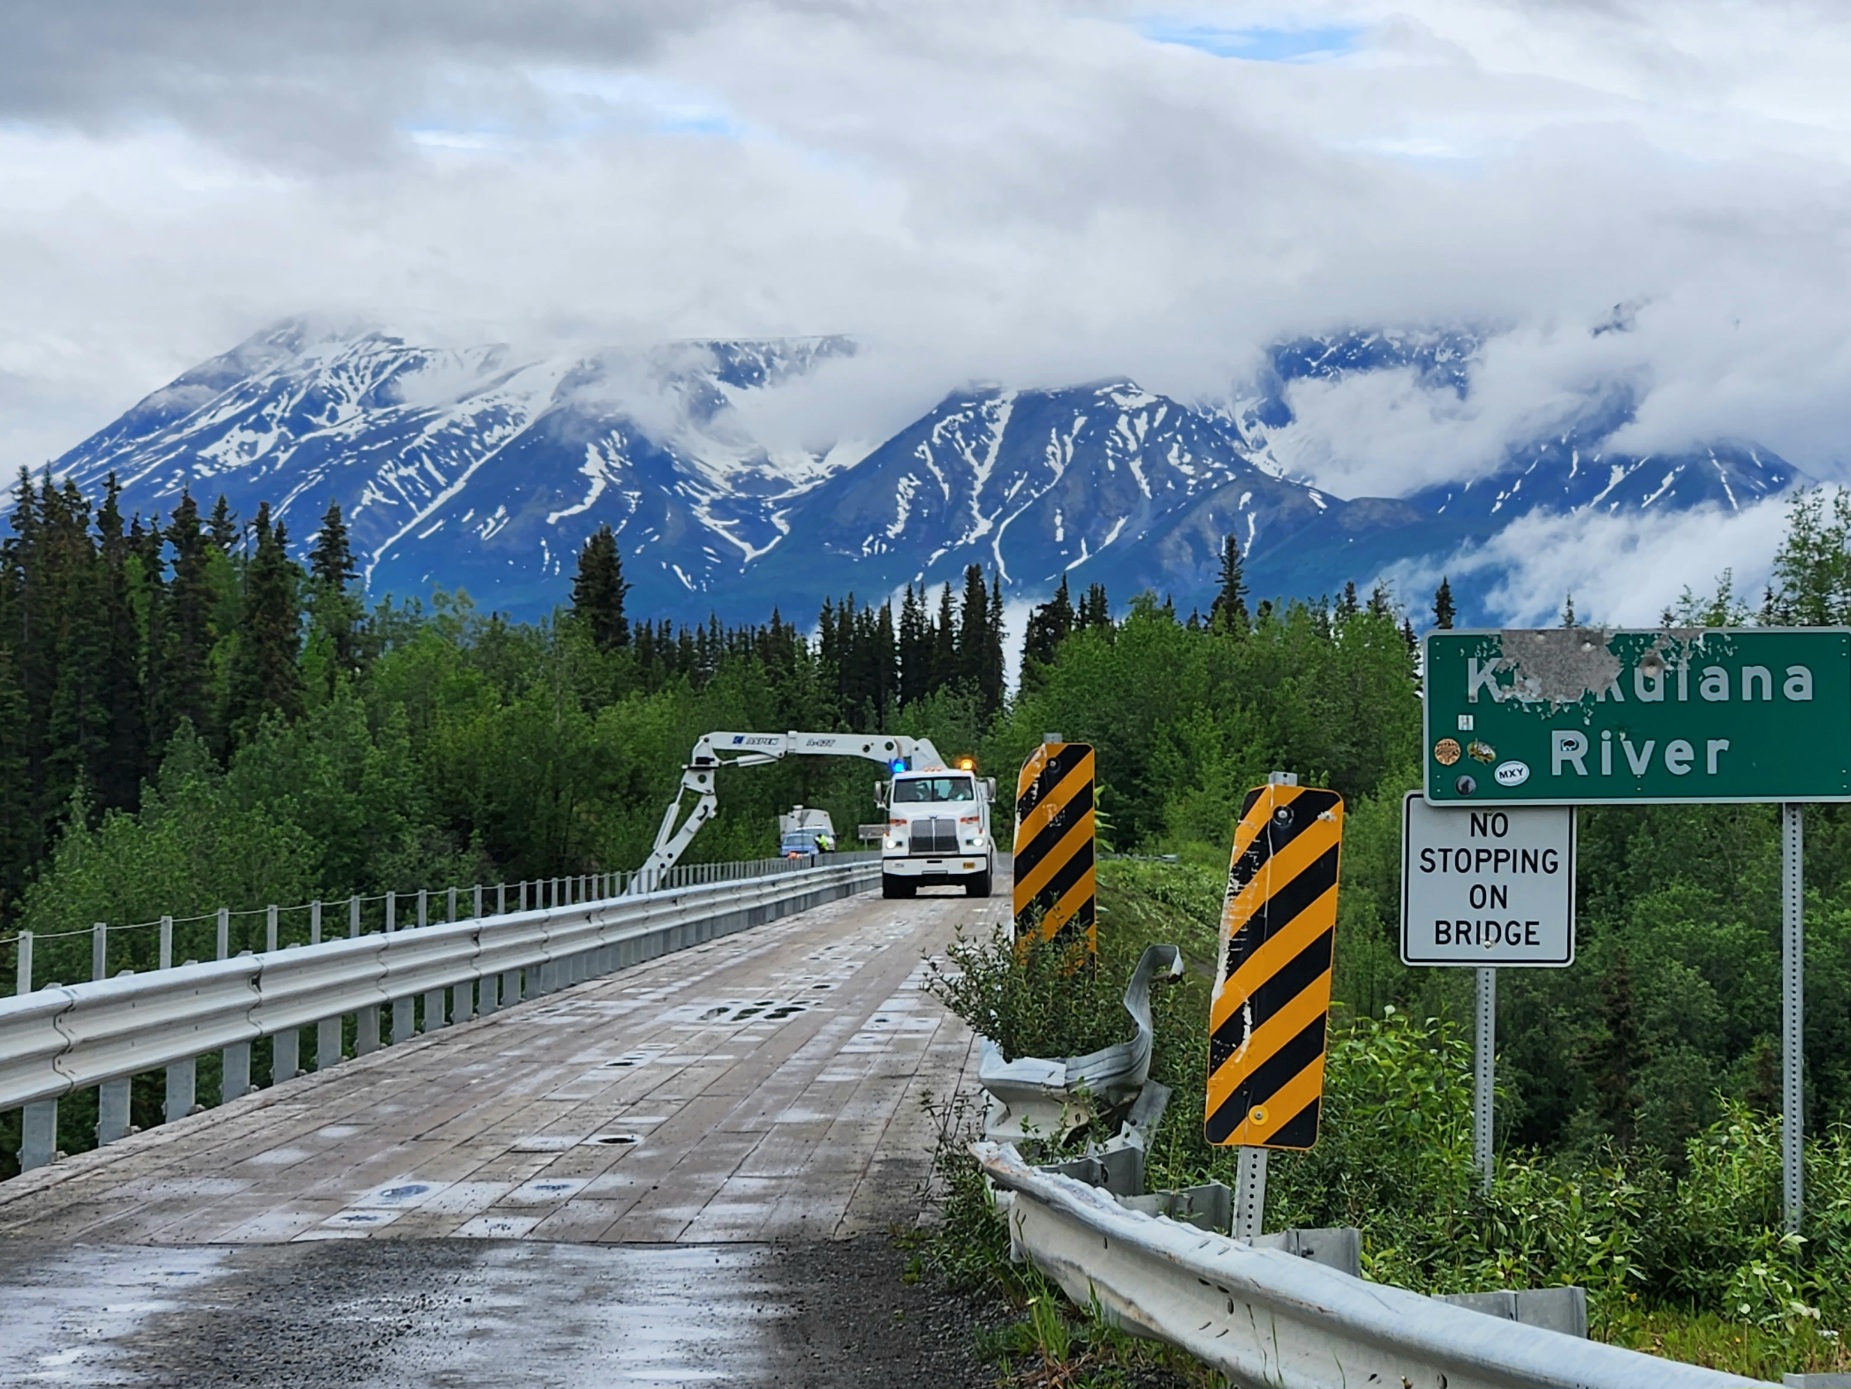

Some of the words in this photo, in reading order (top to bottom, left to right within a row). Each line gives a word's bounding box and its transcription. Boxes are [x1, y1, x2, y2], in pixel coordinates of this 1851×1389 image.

[1551, 730, 1730, 777] River
[1499, 767, 1524, 779] MXY
[1470, 812, 1508, 838] NO
[1420, 848, 1559, 874] STOPPING
[1469, 885, 1508, 910] ON
[1435, 921, 1541, 946] BRIDGE
